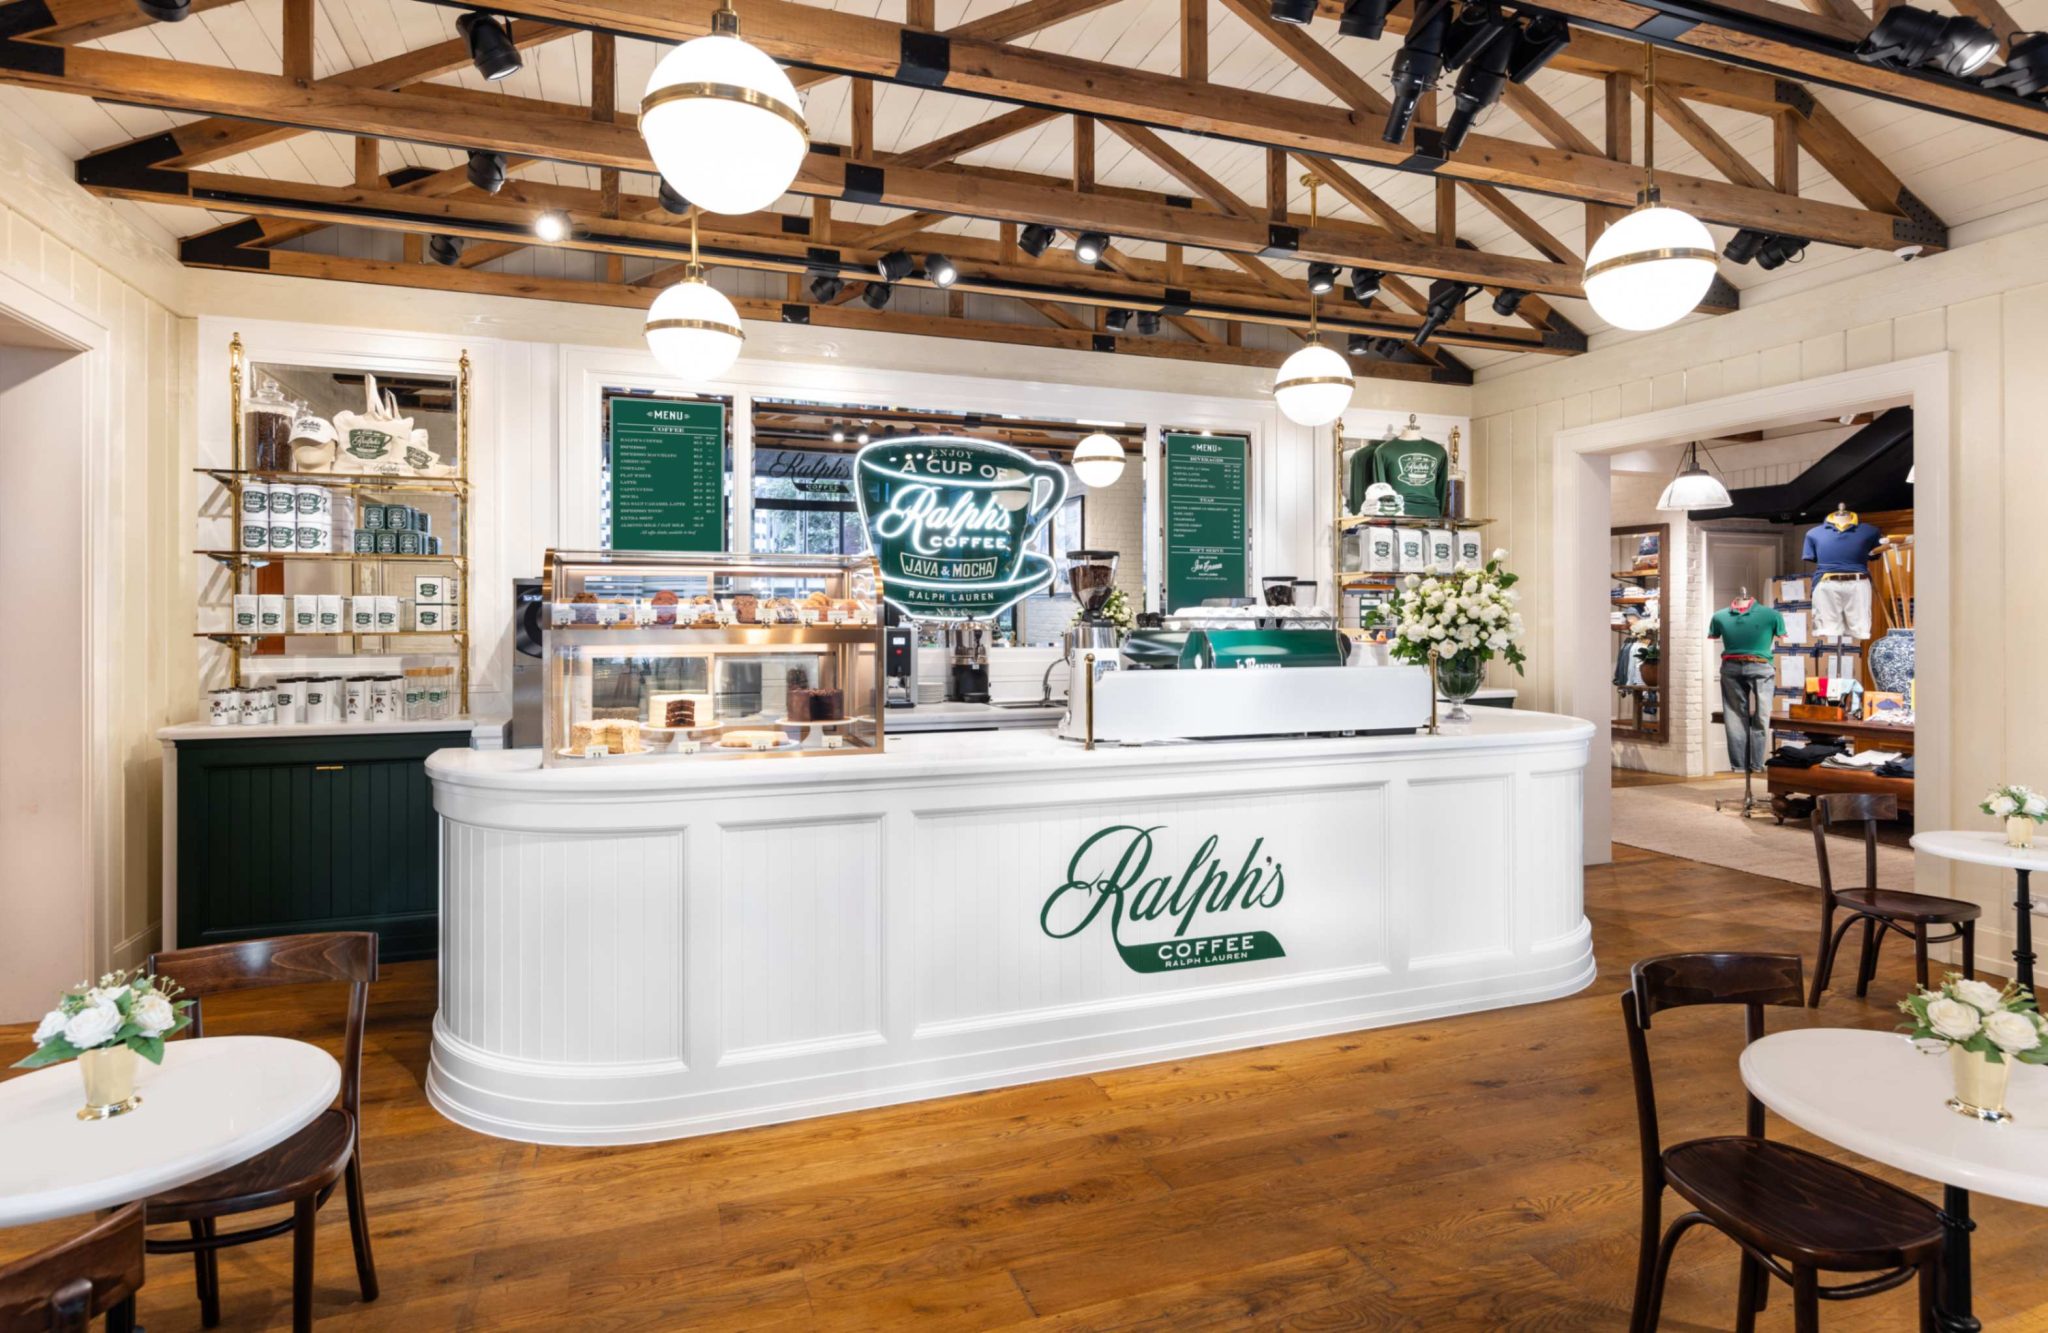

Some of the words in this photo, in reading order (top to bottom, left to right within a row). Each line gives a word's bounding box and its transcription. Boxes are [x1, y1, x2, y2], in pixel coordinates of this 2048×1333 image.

[654, 410, 683, 420] MENU
[930, 448, 974, 459] ENJOY
[1196, 444, 1217, 452] MENU
[768, 451, 850, 483] Ralph's
[900, 460, 917, 473] A
[926, 459, 972, 474] CUP
[980, 466, 1008, 480] OF
[876, 484, 1012, 555] Ralph's
[930, 536, 1007, 550] COFFEE
[905, 558, 939, 577] JAVA
[940, 565, 950, 577] &
[952, 560, 994, 577] MOCHA
[908, 590, 946, 602] RALPH
[950, 591, 994, 602] LAUREN
[1040, 824, 1285, 938] Ralph's
[1158, 934, 1255, 960] COFFEE
[1164, 957, 1201, 968] RALPH
[1204, 951, 1248, 963] LAUREN
